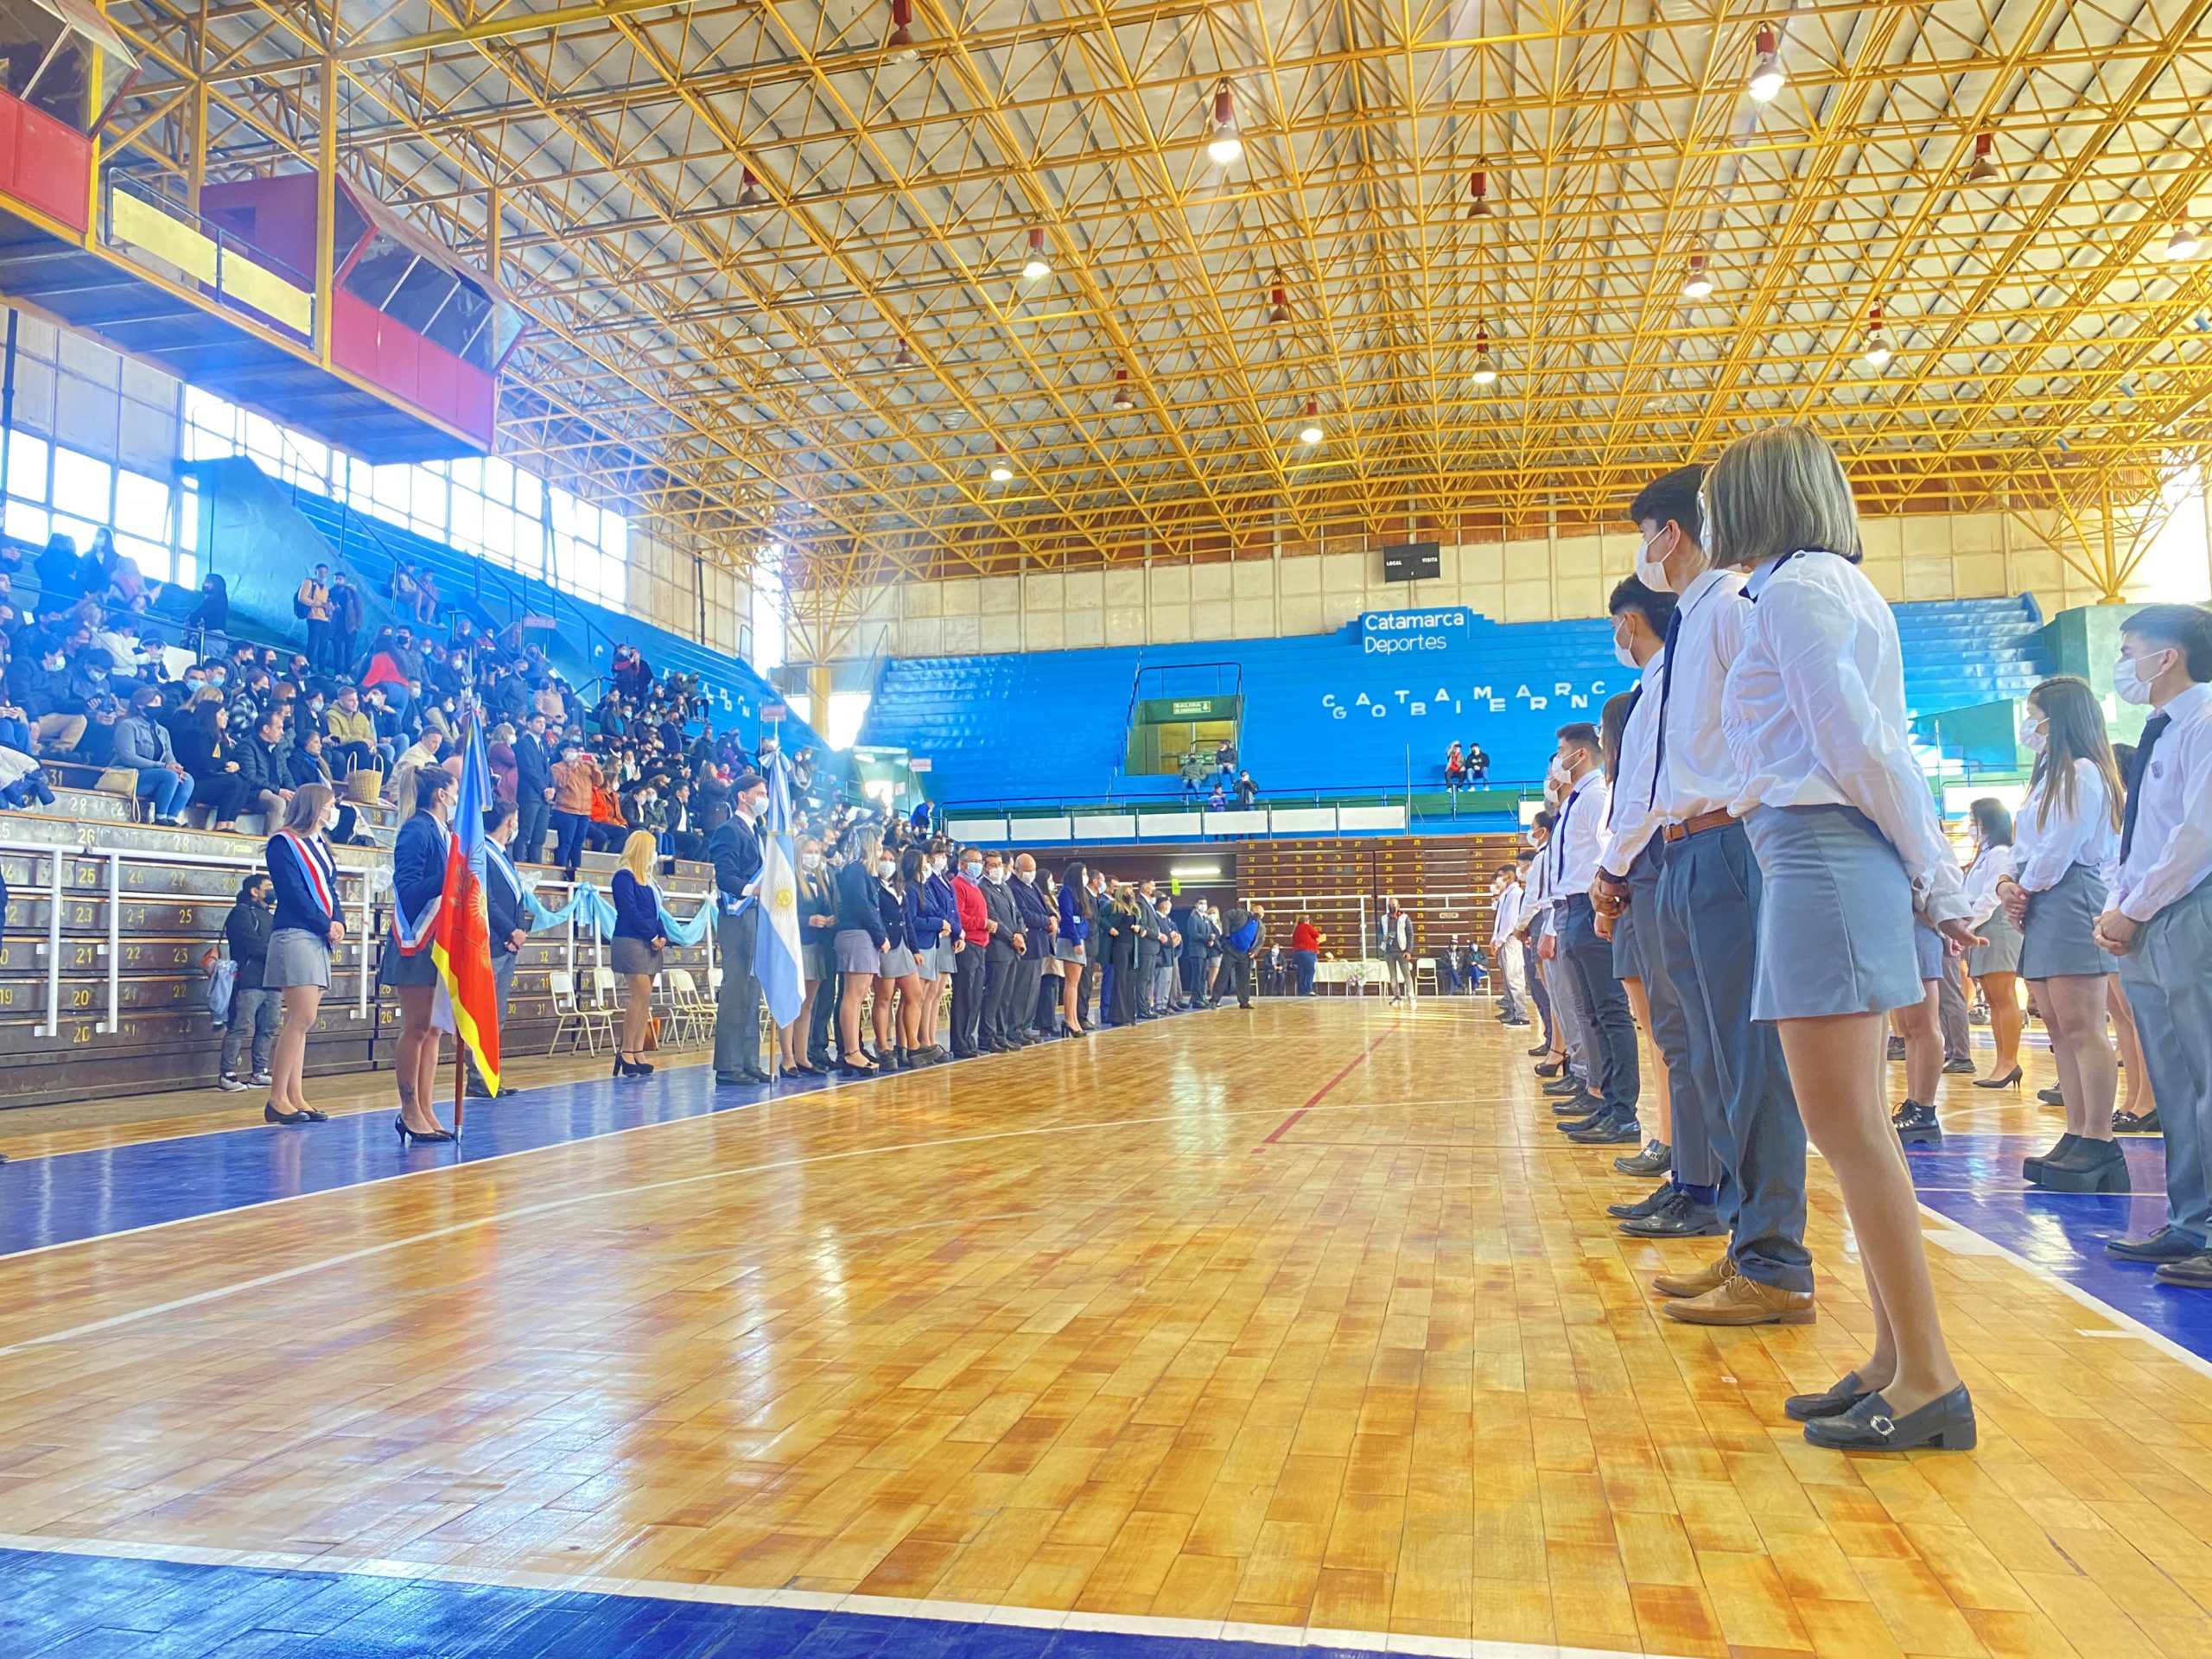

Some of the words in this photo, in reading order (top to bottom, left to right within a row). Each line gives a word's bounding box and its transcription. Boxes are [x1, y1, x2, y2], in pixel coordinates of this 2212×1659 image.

[1365, 613, 1465, 631] Catamarca
[1365, 633, 1446, 655] Deportes
[1332, 694, 1589, 719] GOBIERN
[48, 768, 63, 786] 31
[70, 797, 86, 815] 28
[2, 823, 10, 839] 5
[78, 828, 95, 844] 26
[173, 836, 189, 852] 28
[5, 864, 13, 880] 4
[79, 868, 95, 883] 25
[129, 870, 143, 884] 26
[9, 906, 17, 922] 2
[76, 907, 92, 923] 23
[127, 908, 145, 924] 24
[179, 909, 192, 924] 25
[0, 949, 9, 964] 0
[76, 948, 92, 964] 21
[126, 947, 141, 960] 22
[173, 948, 188, 963] 23
[540, 951, 549, 962] 32
[73, 990, 89, 1007] 20
[173, 985, 187, 998] 22
[508, 1003, 517, 1014] 30
[537, 1003, 545, 1015] 31
[381, 1011, 391, 1024] 26
